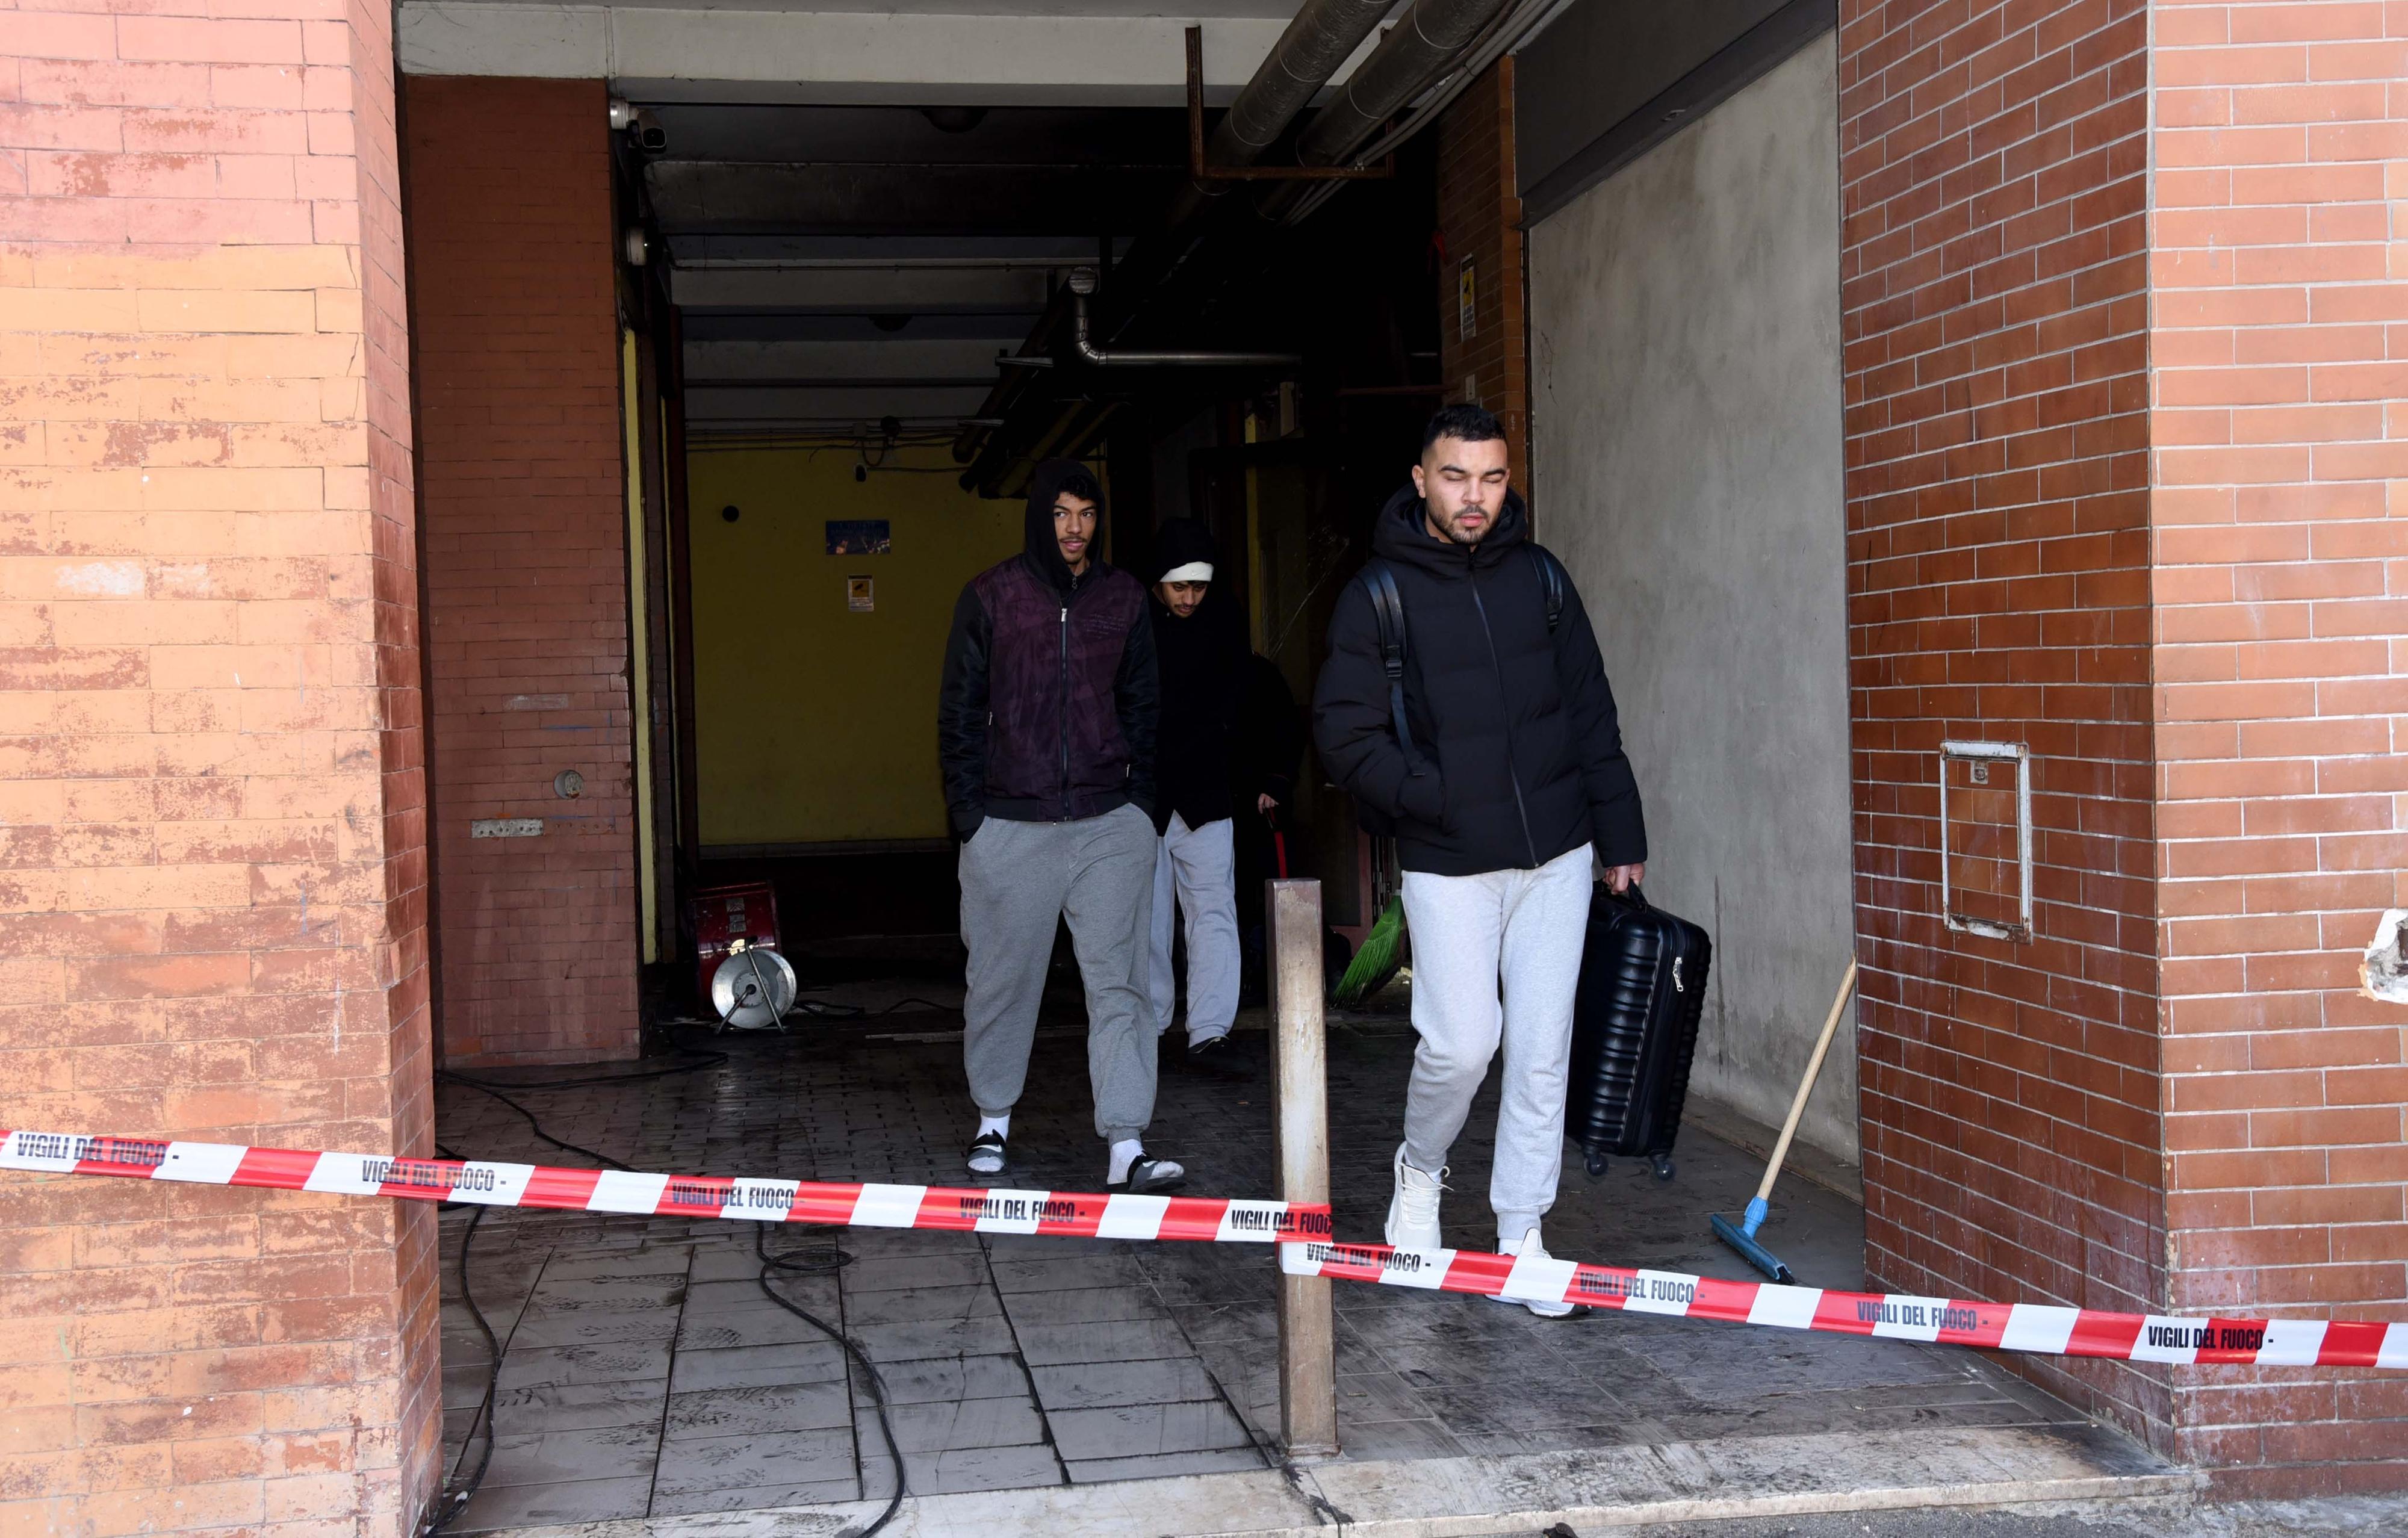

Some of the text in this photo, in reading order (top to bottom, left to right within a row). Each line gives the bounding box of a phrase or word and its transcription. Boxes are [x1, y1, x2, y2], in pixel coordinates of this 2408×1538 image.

[18, 1134, 70, 1159] VIGILI
[73, 1138, 104, 1161] DEL
[110, 1140, 167, 1166] FUOCO
[362, 1160, 408, 1184] VIGILI
[412, 1162, 439, 1187] DEL
[445, 1166, 495, 1191] FUOCO
[672, 1182, 714, 1206] VIGILI
[719, 1185, 743, 1207] DEL
[749, 1186, 794, 1209] FUOCO
[960, 1197, 999, 1219] VIGILI
[1004, 1200, 1026, 1220] DEL
[1032, 1201, 1075, 1221] FUOCO
[1232, 1210, 1269, 1230] VIGILI
[1273, 1212, 1296, 1232] DEL
[1307, 1243, 1345, 1264] VIGILI
[1349, 1248, 1373, 1267] DEL
[1377, 1251, 1421, 1272] FUOCO
[1580, 1273, 1619, 1295] VIGILI
[1623, 1276, 1646, 1298] DEL
[1651, 1280, 1694, 1303] FUOCO
[1857, 1301, 1897, 1324] VIGILI
[1902, 1305, 1926, 1326] DEL
[1931, 1307, 1976, 1330] FUOCO
[2148, 1326, 2189, 1348] VIGILI
[2193, 1328, 2216, 1349] DEL
[2220, 1329, 2264, 1350] FUOCO
